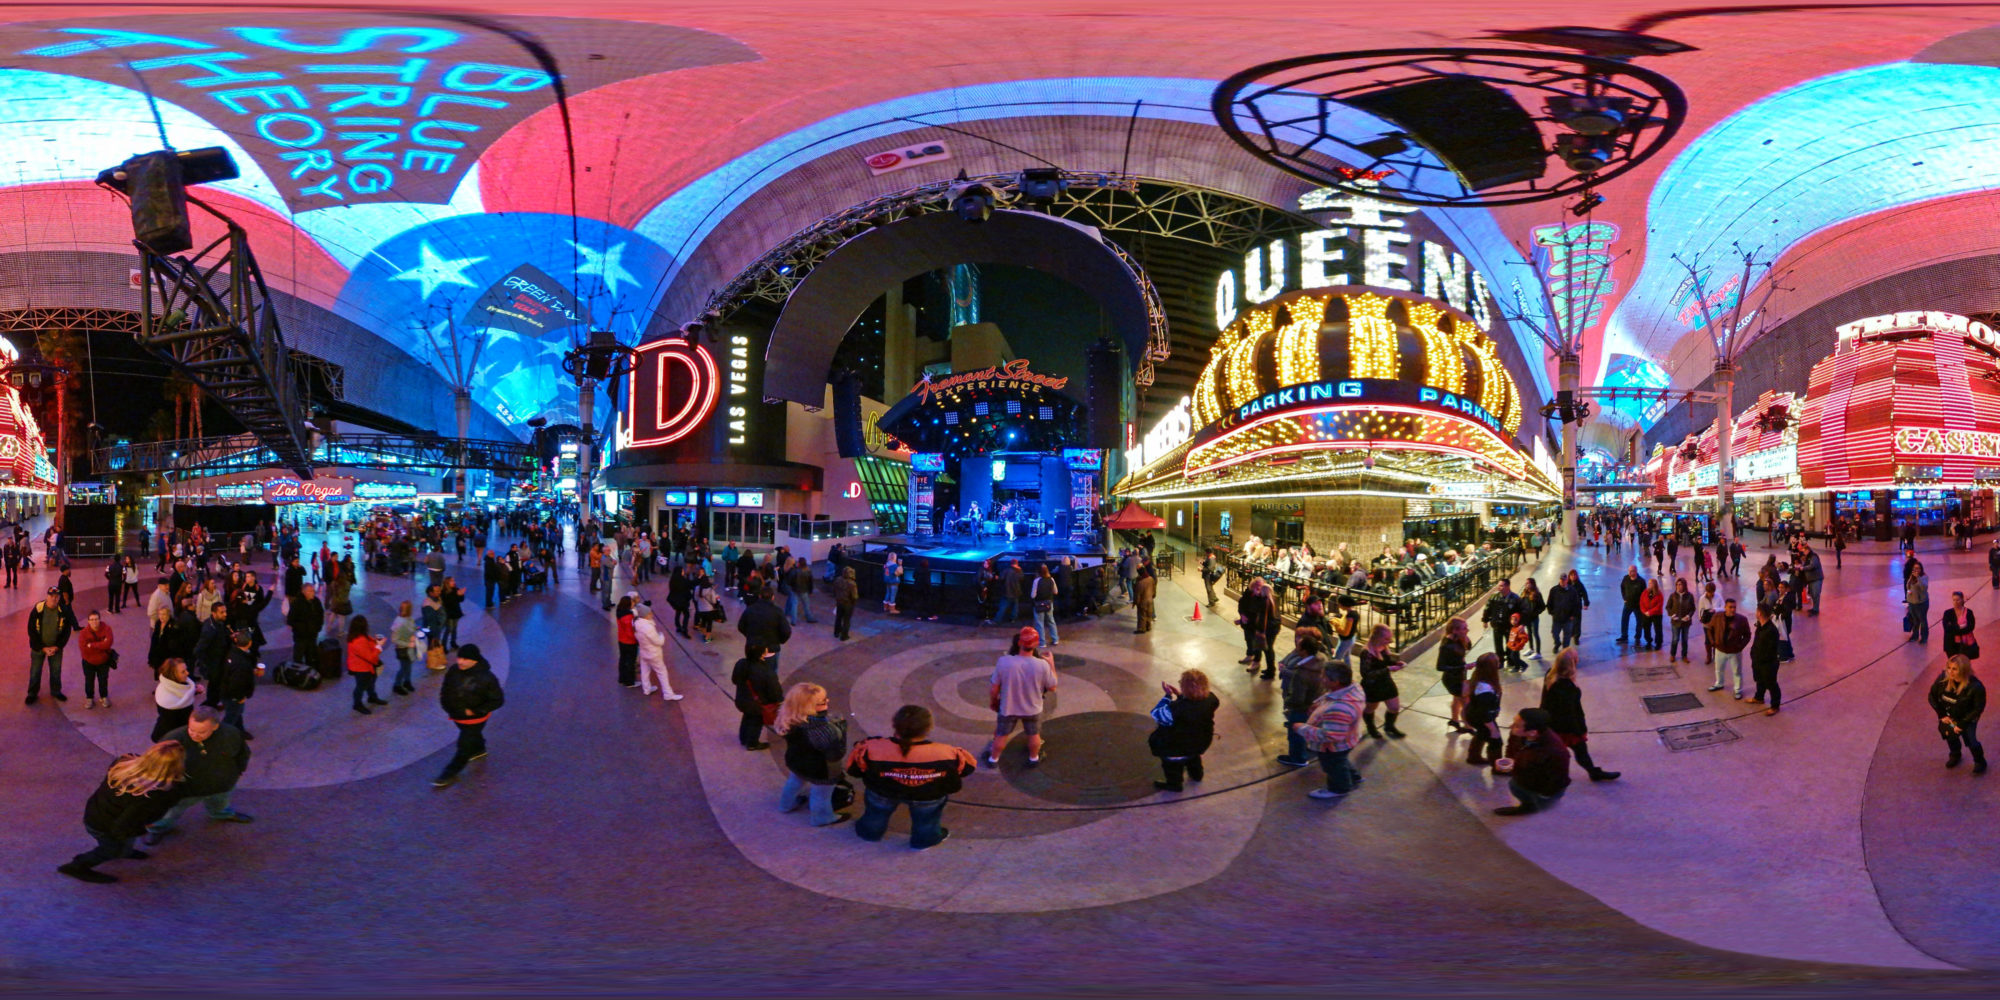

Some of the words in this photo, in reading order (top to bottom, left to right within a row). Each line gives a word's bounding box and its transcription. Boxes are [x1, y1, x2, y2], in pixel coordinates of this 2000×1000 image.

[16, 28, 345, 199] THEORY
[223, 27, 462, 195] STRING
[402, 61, 565, 173] BLUE
[504, 276, 557, 303] GREEN
[1216, 227, 1491, 331] QUEENS
[1836, 311, 2000, 355] FREMO
[730, 334, 749, 396] VEGAS
[910, 365, 997, 406] Fremont
[996, 358, 1068, 390] Street
[935, 380, 1042, 400] EXPERIENCE
[629, 338, 719, 448] D
[1240, 382, 1362, 420] PARKING
[1419, 387, 1501, 432] PARKING
[729, 404, 746, 445] LAS
[272, 483, 298, 496] Las
[301, 483, 343, 501] Vegas
